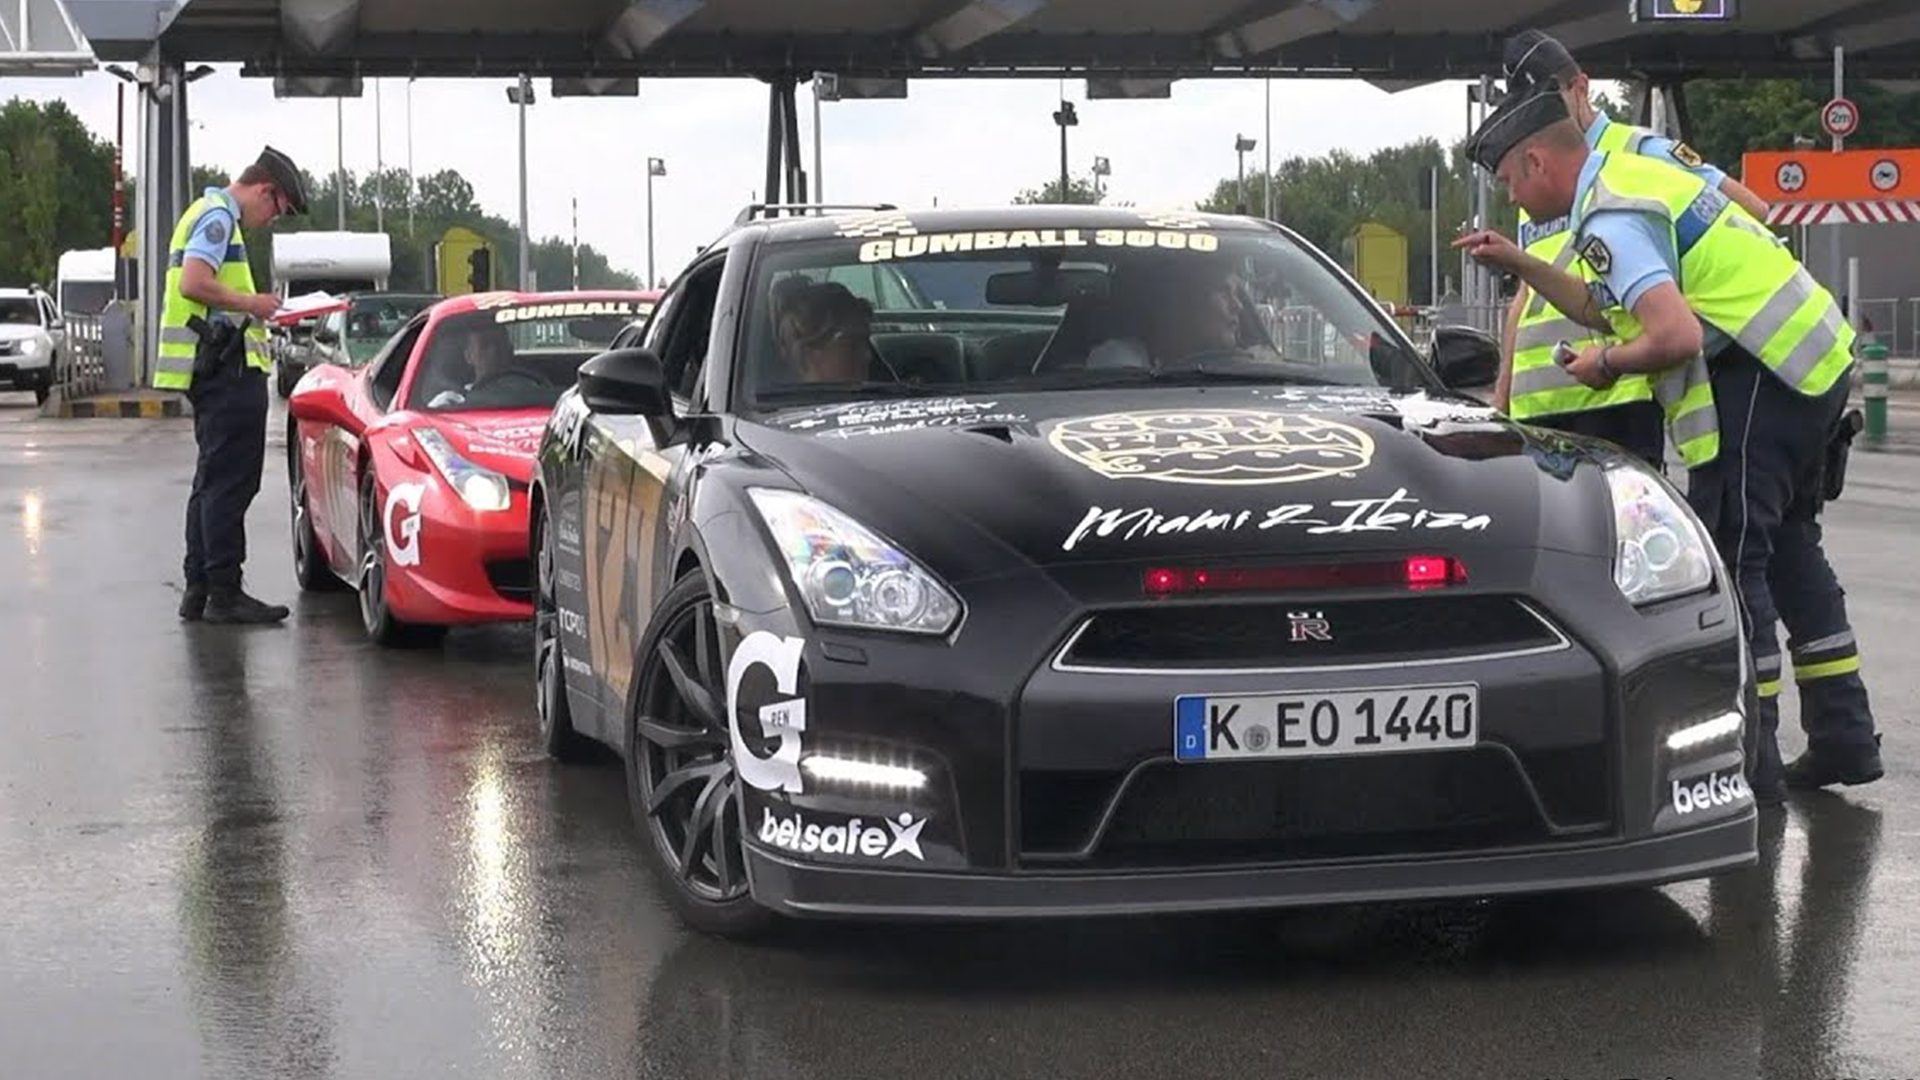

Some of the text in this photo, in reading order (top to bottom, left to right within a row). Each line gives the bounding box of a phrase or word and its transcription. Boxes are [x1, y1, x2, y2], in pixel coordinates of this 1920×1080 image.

[858, 228, 1218, 263] GUMBALL 3000
[494, 302, 633, 324] GUMBALL
[1061, 506, 1252, 551] Miami
[1306, 487, 1492, 534] Ibiza
[1185, 734, 1197, 750] D
[1209, 704, 1240, 750] K
[1354, 693, 1473, 746] 1440
